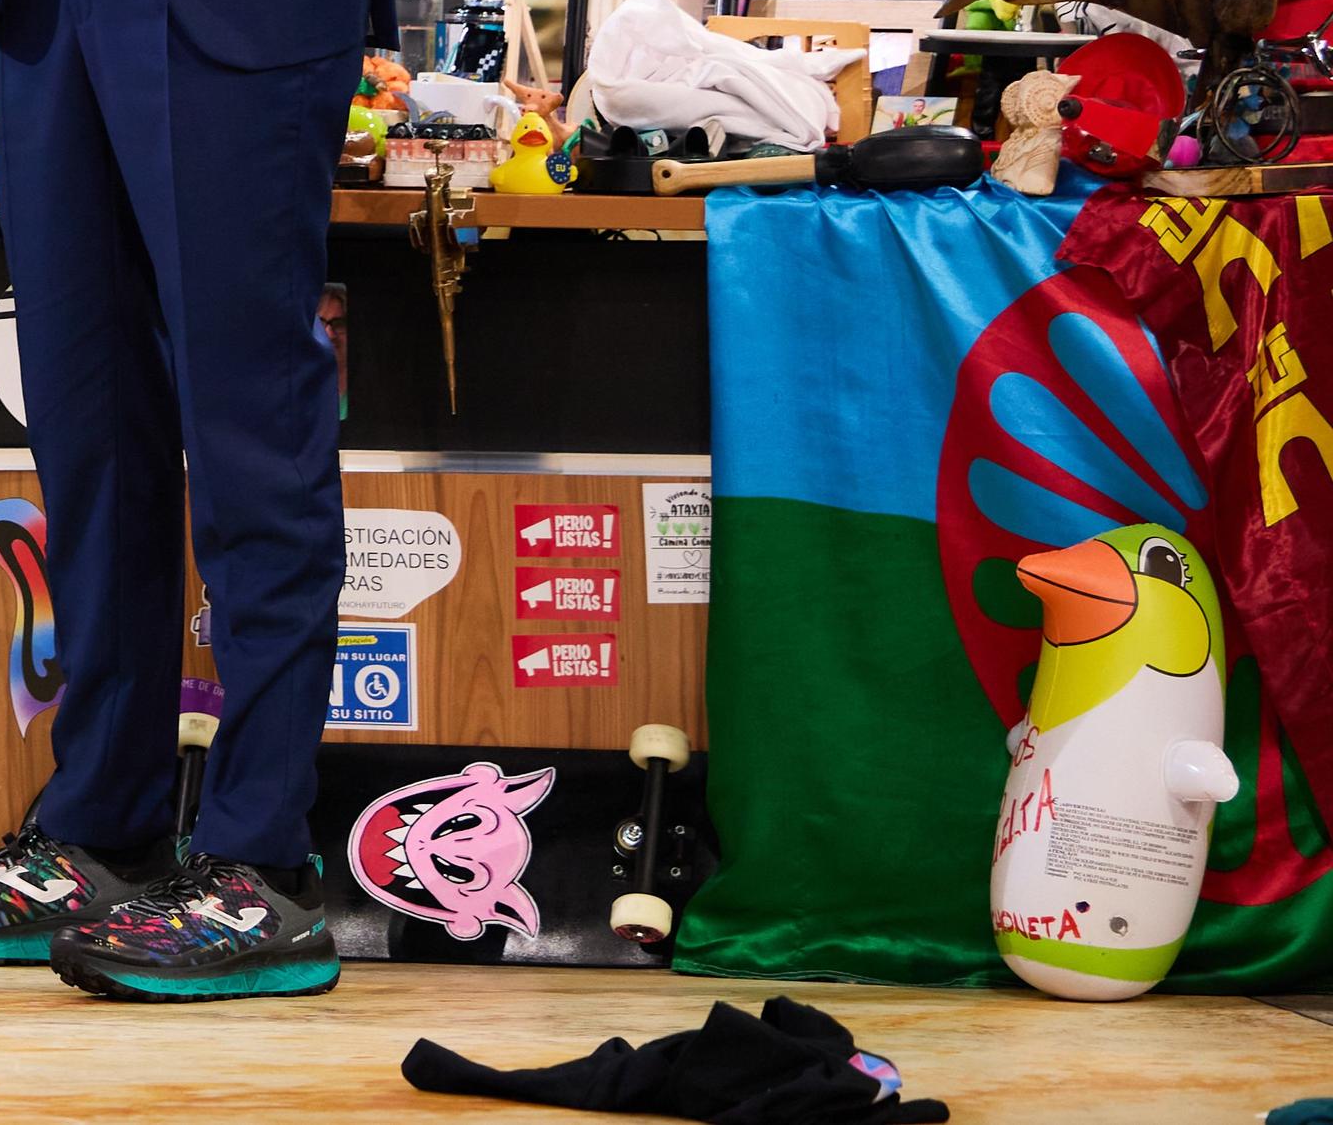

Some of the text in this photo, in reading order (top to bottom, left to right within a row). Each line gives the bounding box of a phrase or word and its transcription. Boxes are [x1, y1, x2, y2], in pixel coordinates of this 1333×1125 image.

[555, 163, 566, 172] EU
[671, 504, 710, 515] ATAXIA
[555, 515, 594, 531] PERIO
[345, 552, 449, 569] MEDADES
[555, 578, 594, 594] PERIO
[369, 653, 406, 662] LUGAR
[551, 644, 591, 660] PERIO
[331, 709, 393, 720] SU SITIO
